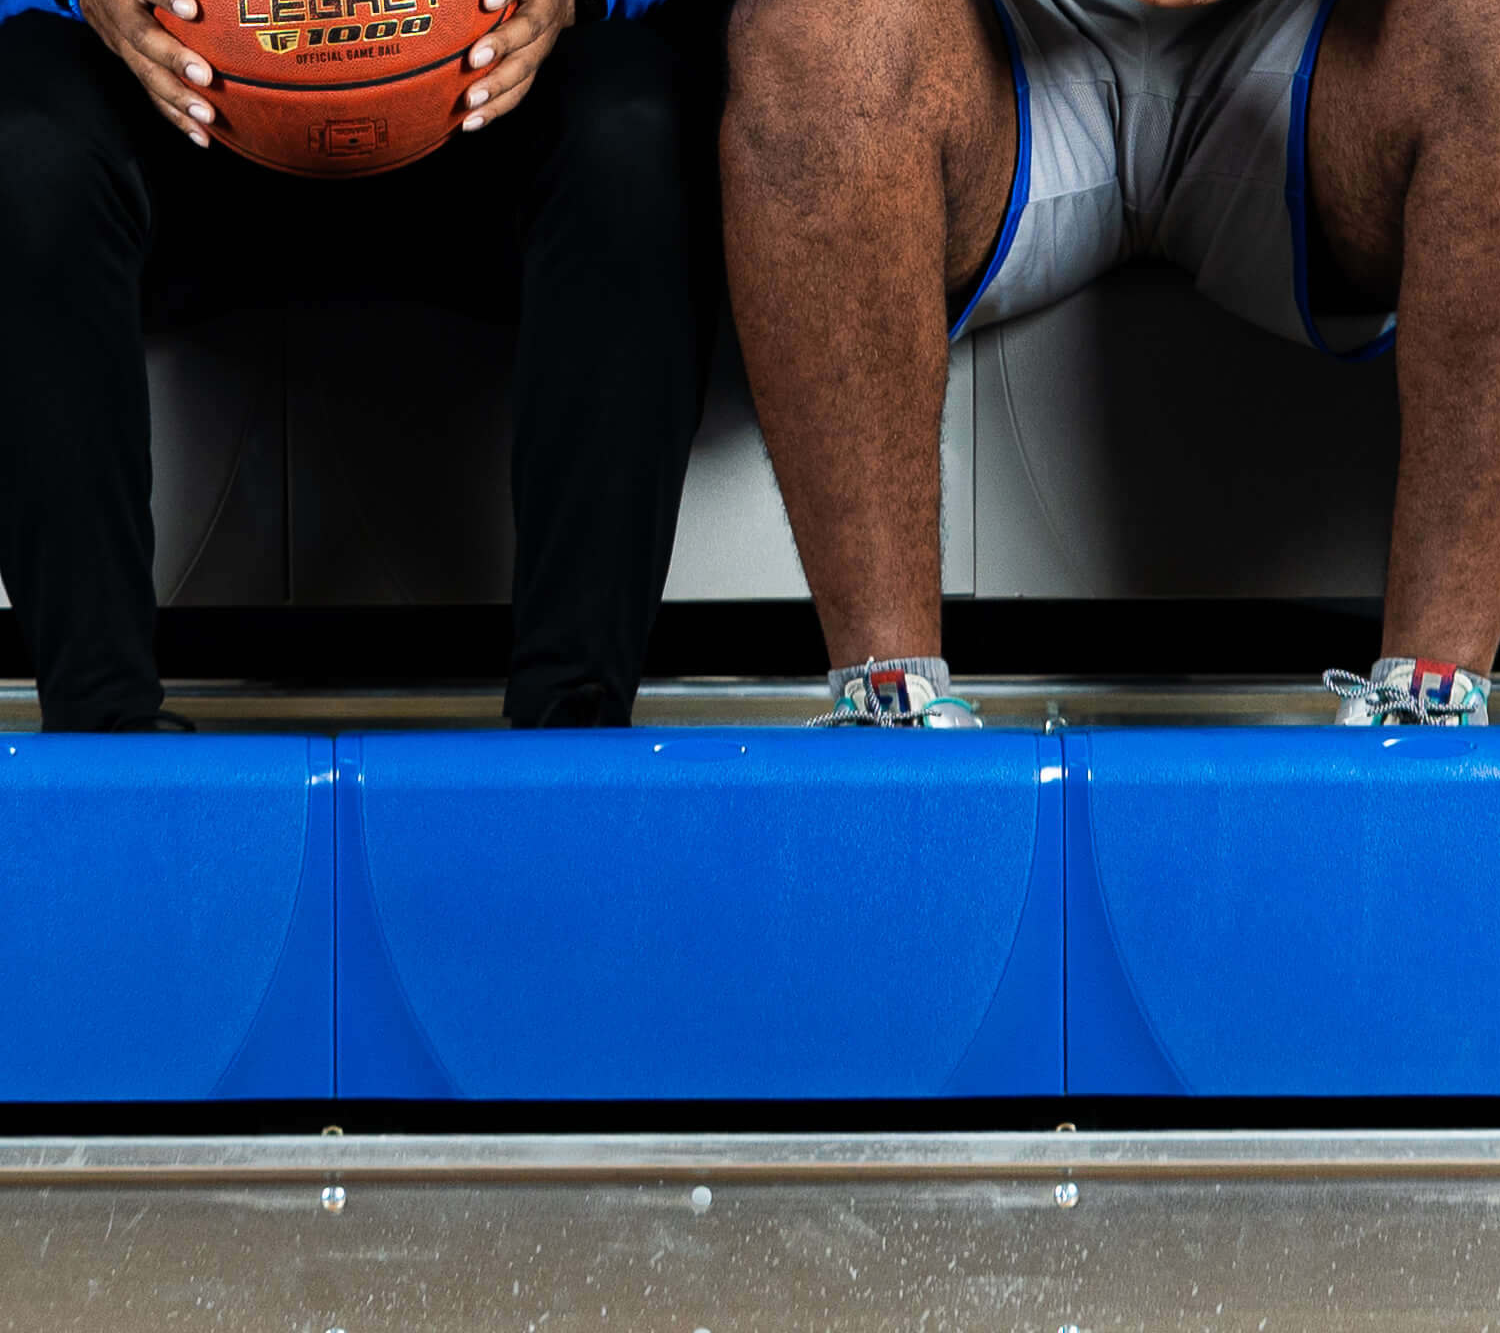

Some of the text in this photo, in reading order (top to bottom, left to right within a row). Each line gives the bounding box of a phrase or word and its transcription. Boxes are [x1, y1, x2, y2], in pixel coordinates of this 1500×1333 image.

[306, 14, 433, 47] 1000
[295, 44, 401, 65] OFFICIAL GAME BALL
